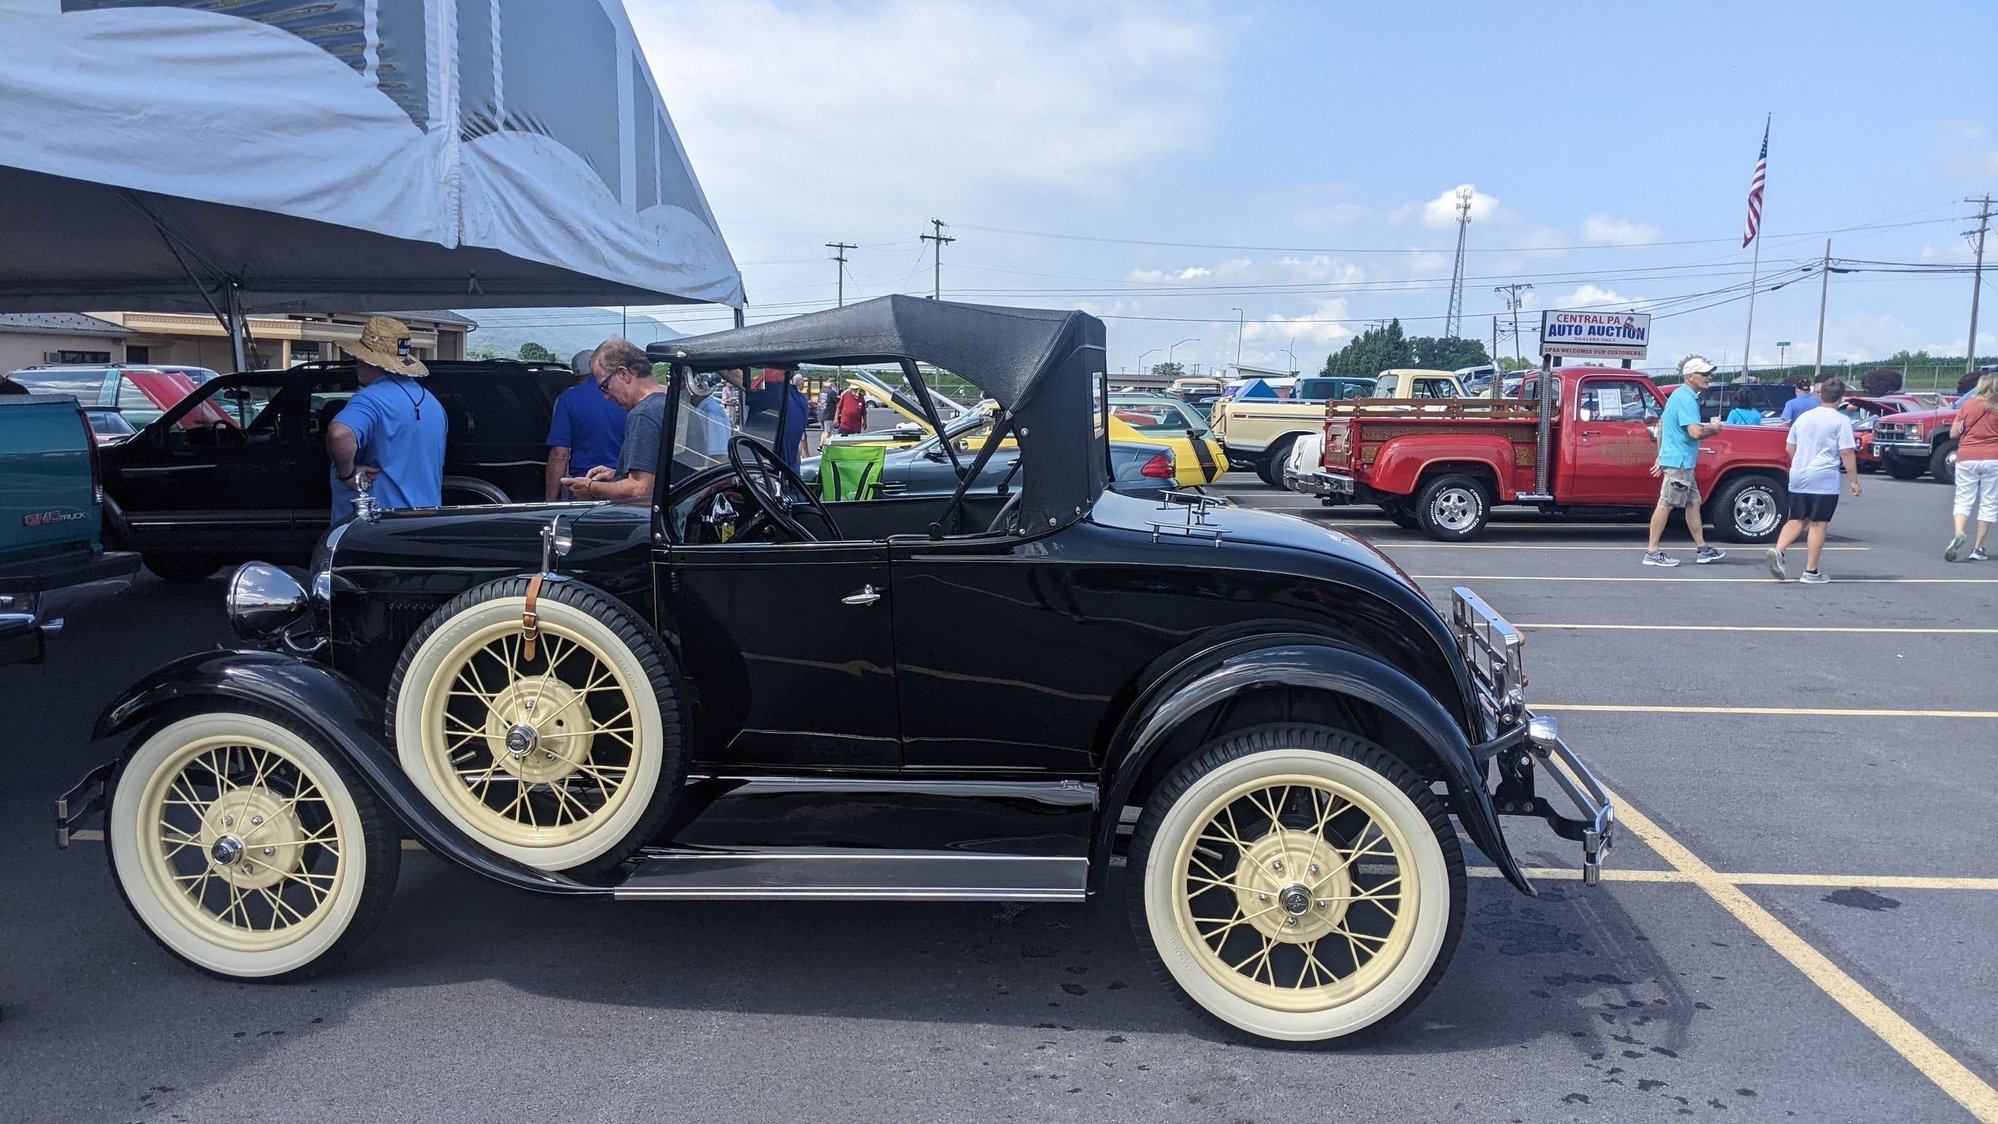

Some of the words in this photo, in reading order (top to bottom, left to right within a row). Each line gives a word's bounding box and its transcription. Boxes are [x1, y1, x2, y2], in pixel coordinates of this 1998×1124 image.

[1556, 314, 1604, 325] CENTRAL
[1607, 315, 1620, 325] PA
[1548, 323, 1582, 337] AUTO
[1587, 325, 1645, 340] AUCTION
[1469, 488, 1483, 516] COOPER
[24, 511, 60, 527] GMC
[60, 512, 86, 521] TRUCK
[1458, 517, 1480, 534] COBRA
[1760, 513, 1782, 537] COOPER
[1735, 524, 1757, 537] COBRA
